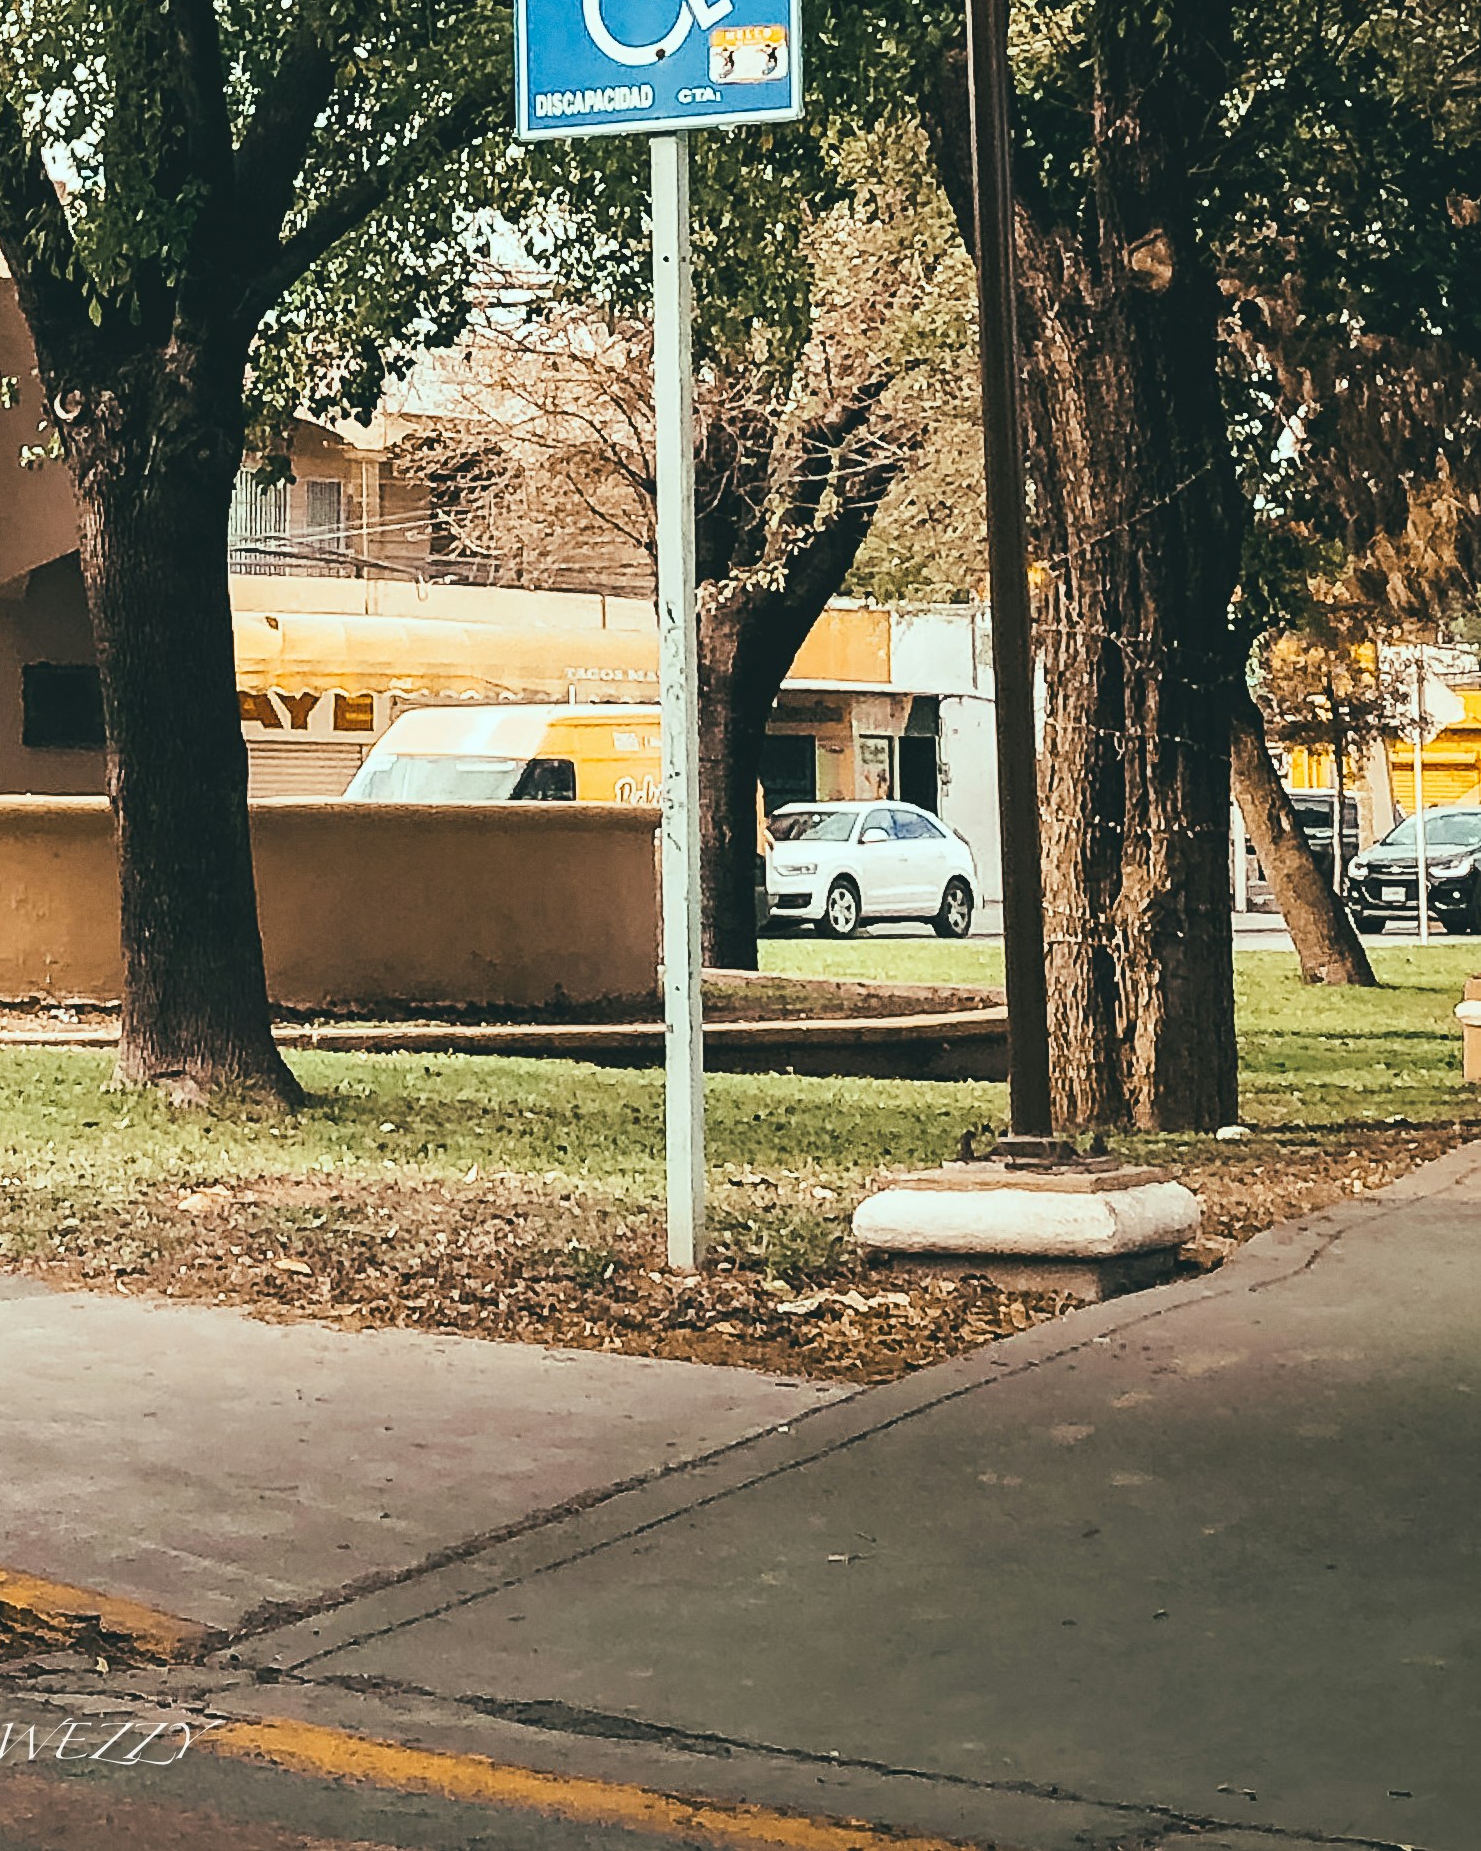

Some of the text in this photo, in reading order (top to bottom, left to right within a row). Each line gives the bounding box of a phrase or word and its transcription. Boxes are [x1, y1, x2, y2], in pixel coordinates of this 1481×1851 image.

[534, 84, 654, 118] DISCAPACIDAD
[564, 667, 661, 684] TACOS MA
